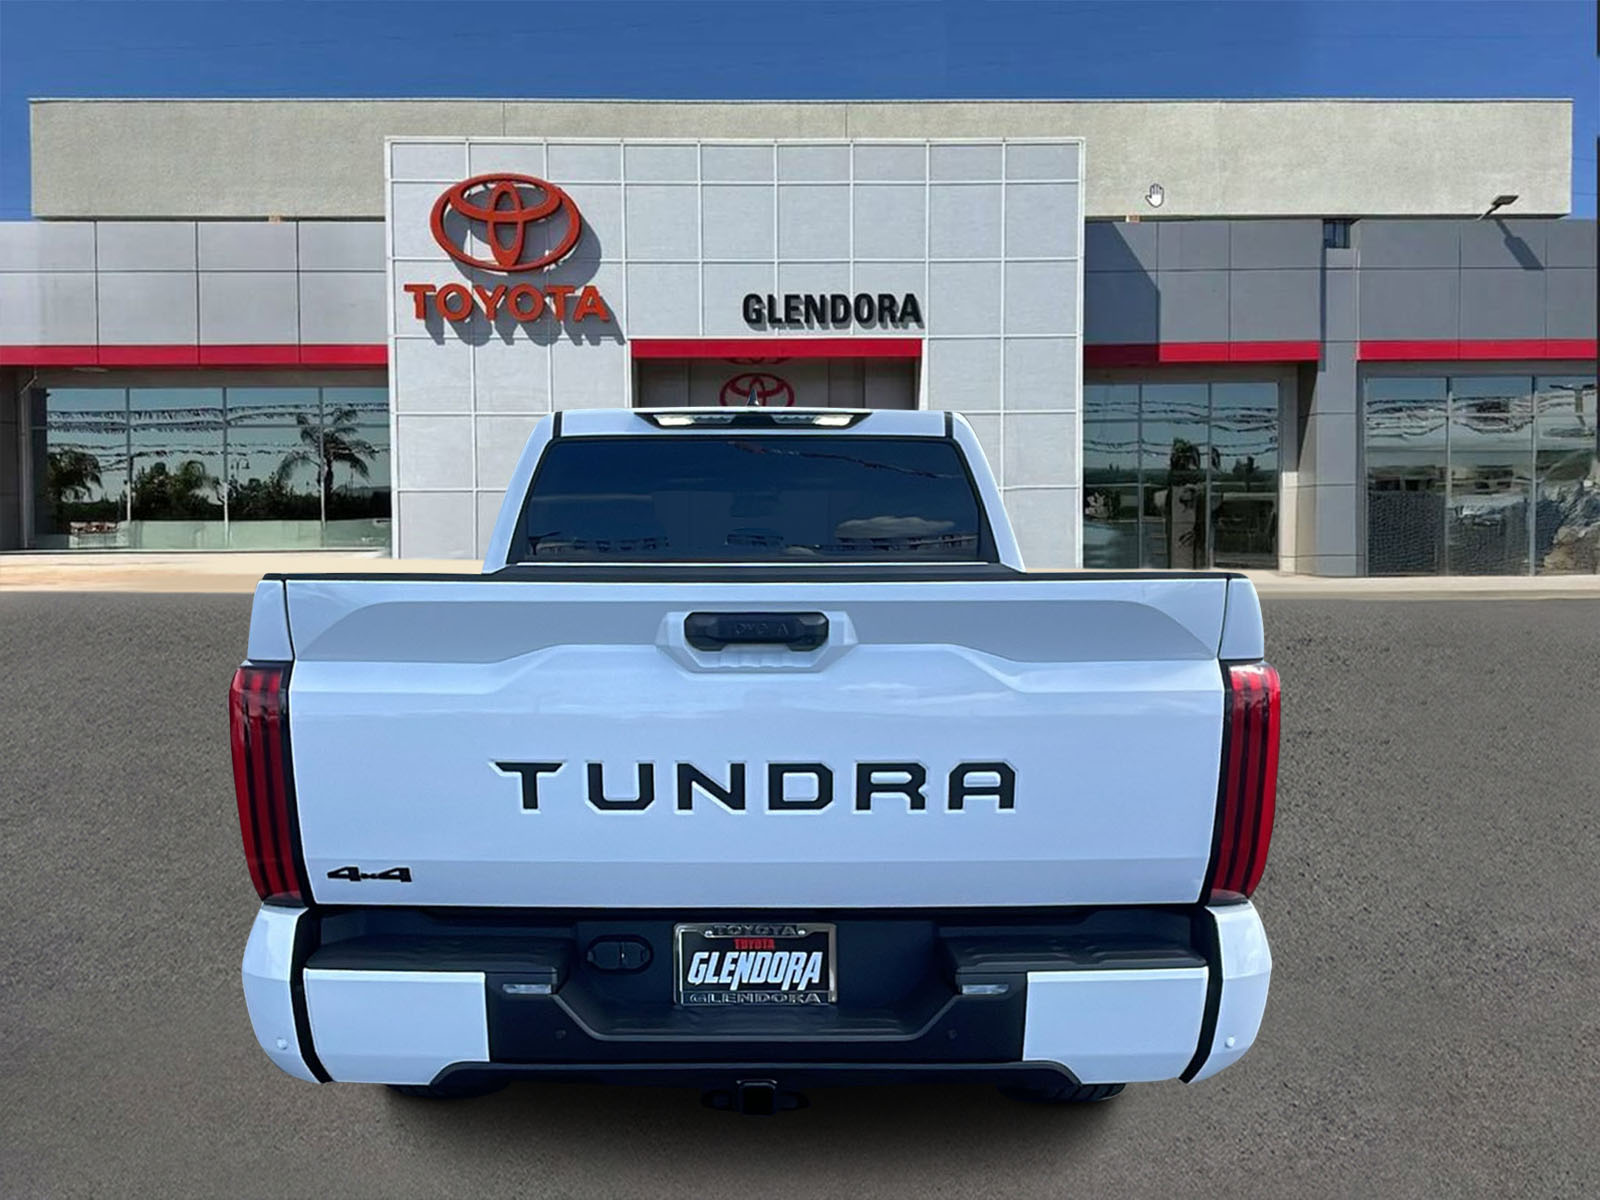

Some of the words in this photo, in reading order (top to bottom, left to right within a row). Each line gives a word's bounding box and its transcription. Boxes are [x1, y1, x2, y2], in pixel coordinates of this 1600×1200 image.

[404, 283, 612, 323] TOYOTA
[742, 293, 922, 325] GLENDORA
[492, 760, 1017, 813] TUNDRA
[713, 925, 797, 936] TOYOTA
[733, 938, 775, 950] TOYOTA
[687, 951, 823, 991] GLENDORA
[689, 992, 822, 1004] GLENDORA
